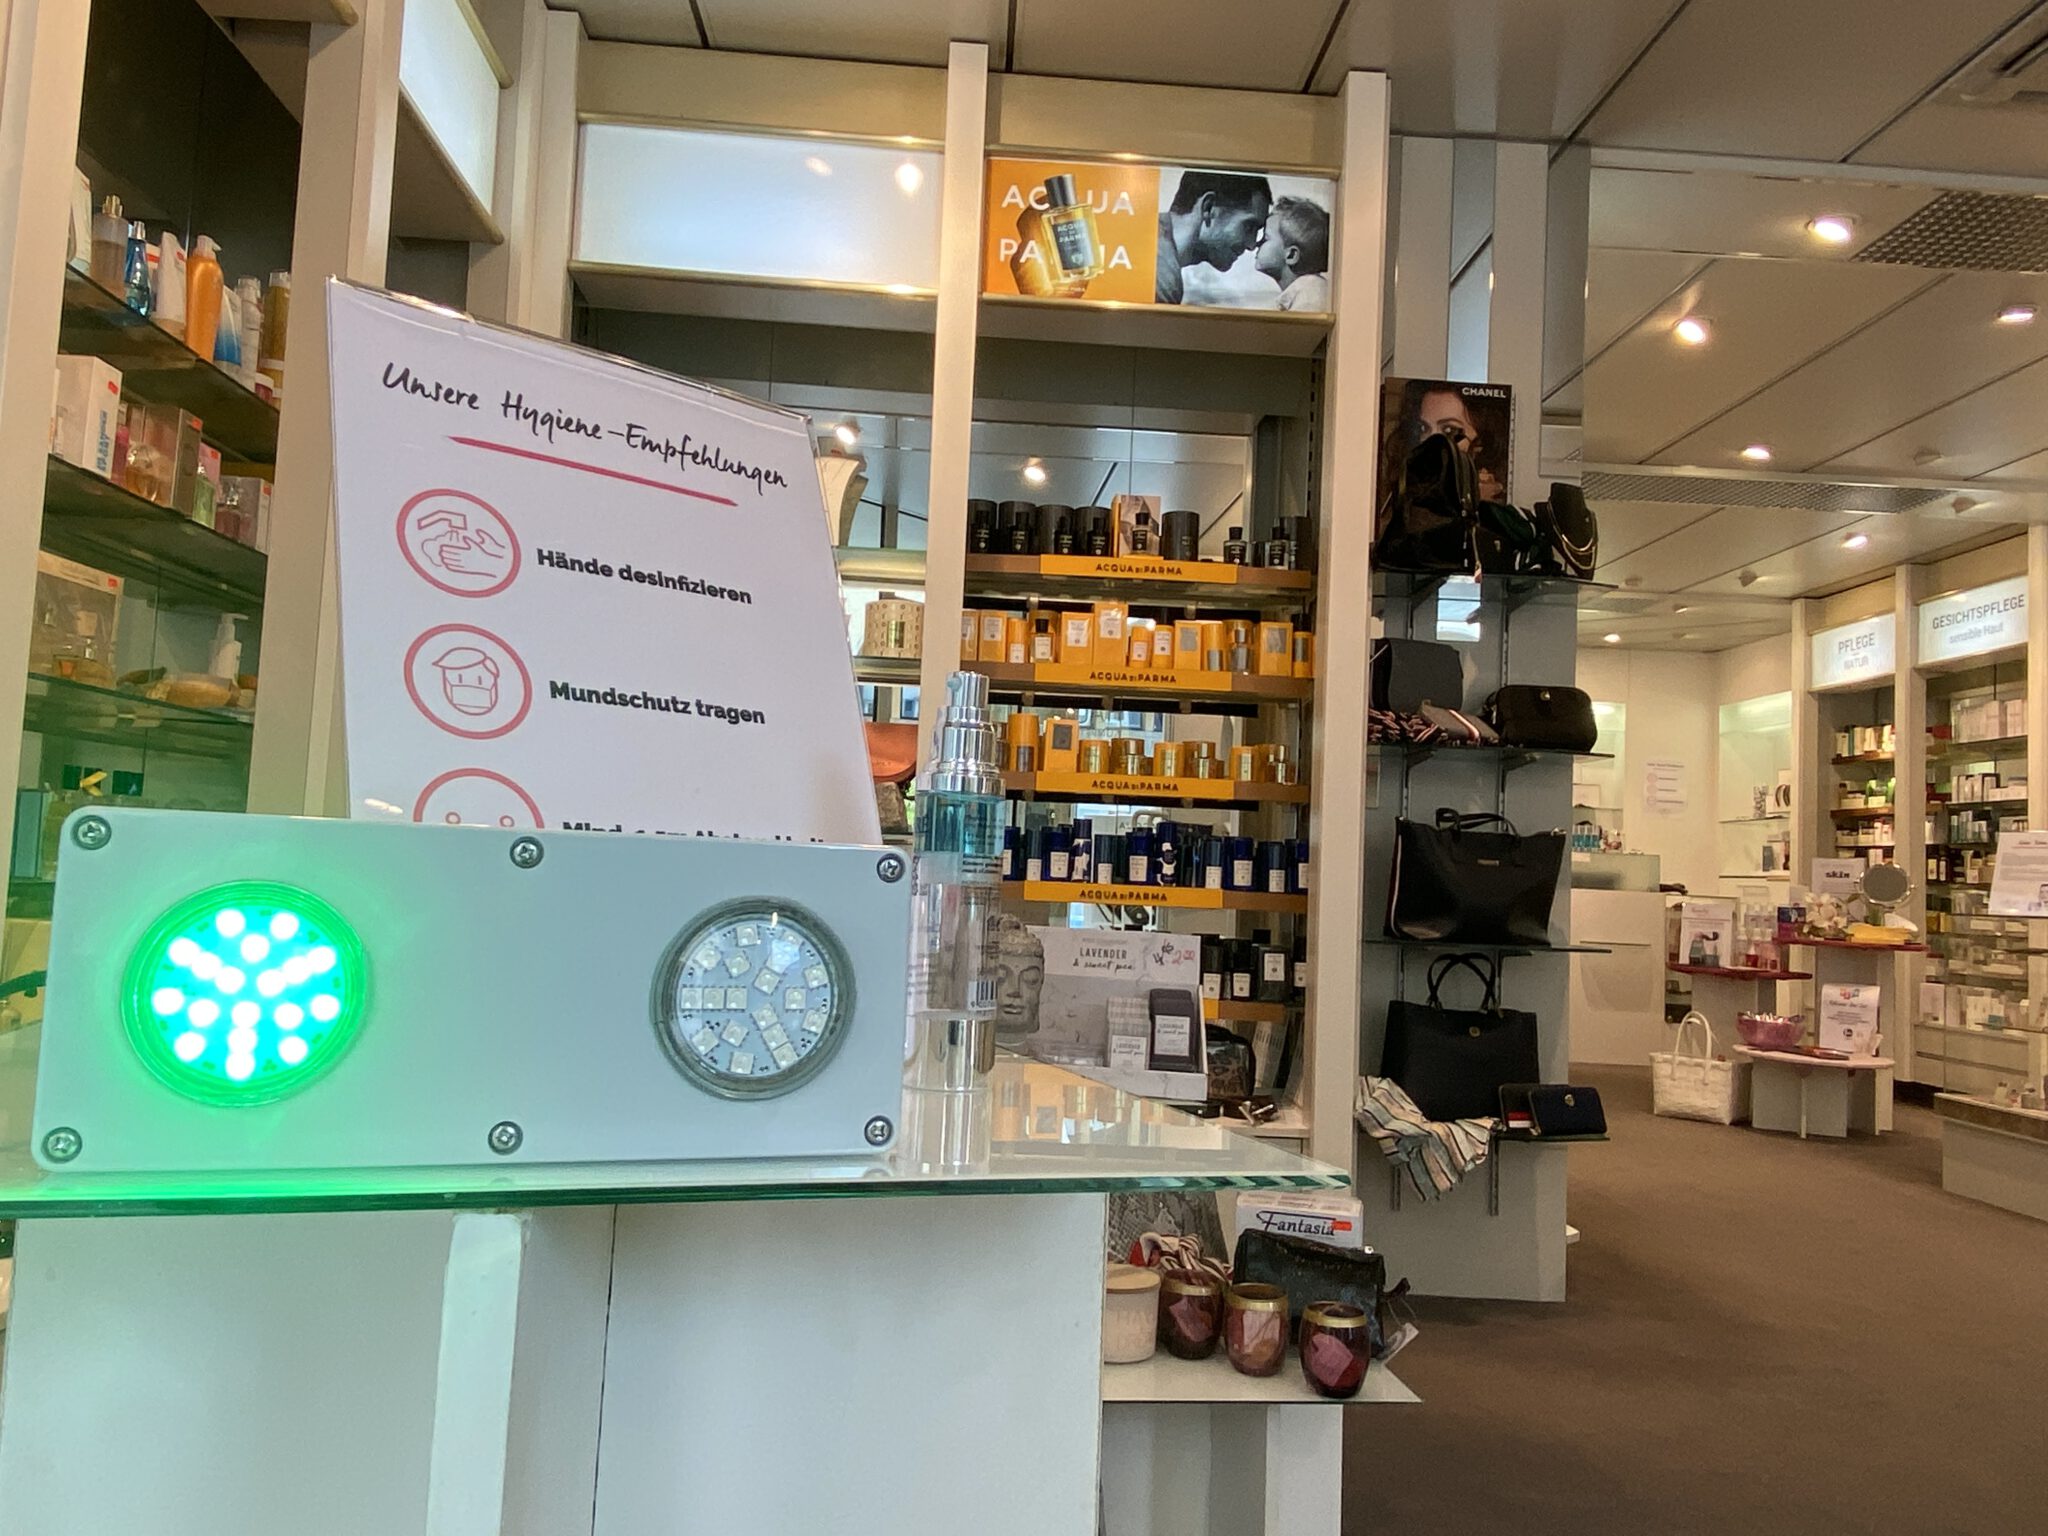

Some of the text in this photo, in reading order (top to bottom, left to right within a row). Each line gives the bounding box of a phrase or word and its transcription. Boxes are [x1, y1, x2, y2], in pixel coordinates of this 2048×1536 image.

[1001, 185, 1135, 216] ACUA
[999, 238, 1133, 270] PAA
[1462, 386, 1506, 398] CHANEL
[383, 362, 788, 496] Unsere Hygiene-Empfehlungen
[536, 548, 753, 604] Hände desinfizieren
[1096, 563, 1133, 573] ACQUA
[1144, 565, 1182, 575] PARMA
[1932, 594, 2025, 630] GESICHTSPFLEGE
[1838, 632, 1875, 655] PFLEGE
[1089, 671, 1128, 681] ACQUA
[1138, 673, 1177, 683] PARMA
[549, 680, 766, 725] Mundschutz tragen
[1091, 780, 1130, 790] ACQUA
[1140, 782, 1179, 791] PARMA
[1079, 889, 1118, 900] ACQUA
[1128, 892, 1168, 901] PARMA
[1080, 947, 1127, 959] LAVENDER
[1256, 1210, 1336, 1236] Fantasia
